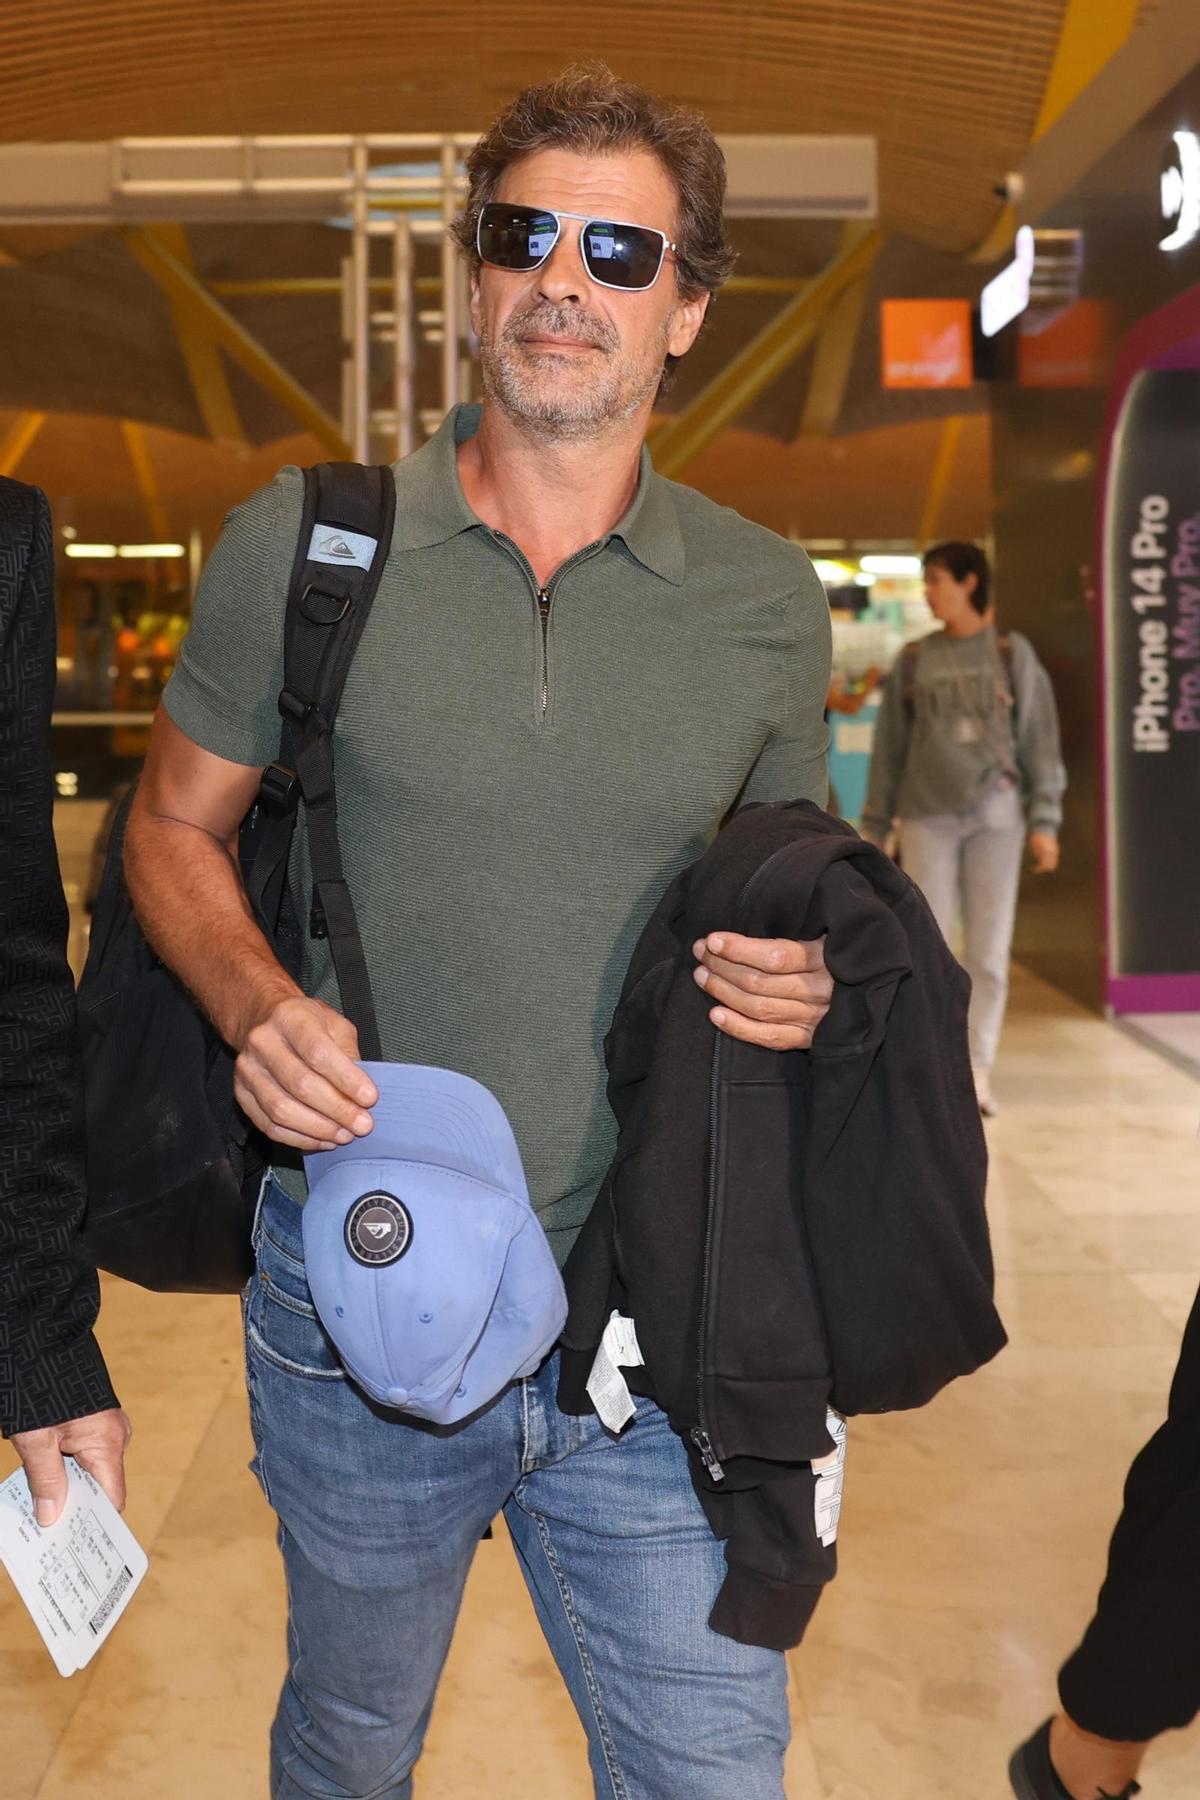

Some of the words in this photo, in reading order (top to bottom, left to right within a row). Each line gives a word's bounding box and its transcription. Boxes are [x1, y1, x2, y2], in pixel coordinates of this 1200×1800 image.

[1131, 495, 1169, 559] Pro
[1131, 566, 1167, 614] 14
[1172, 583, 1200, 658] Muy
[1133, 618, 1169, 752] iPhone
